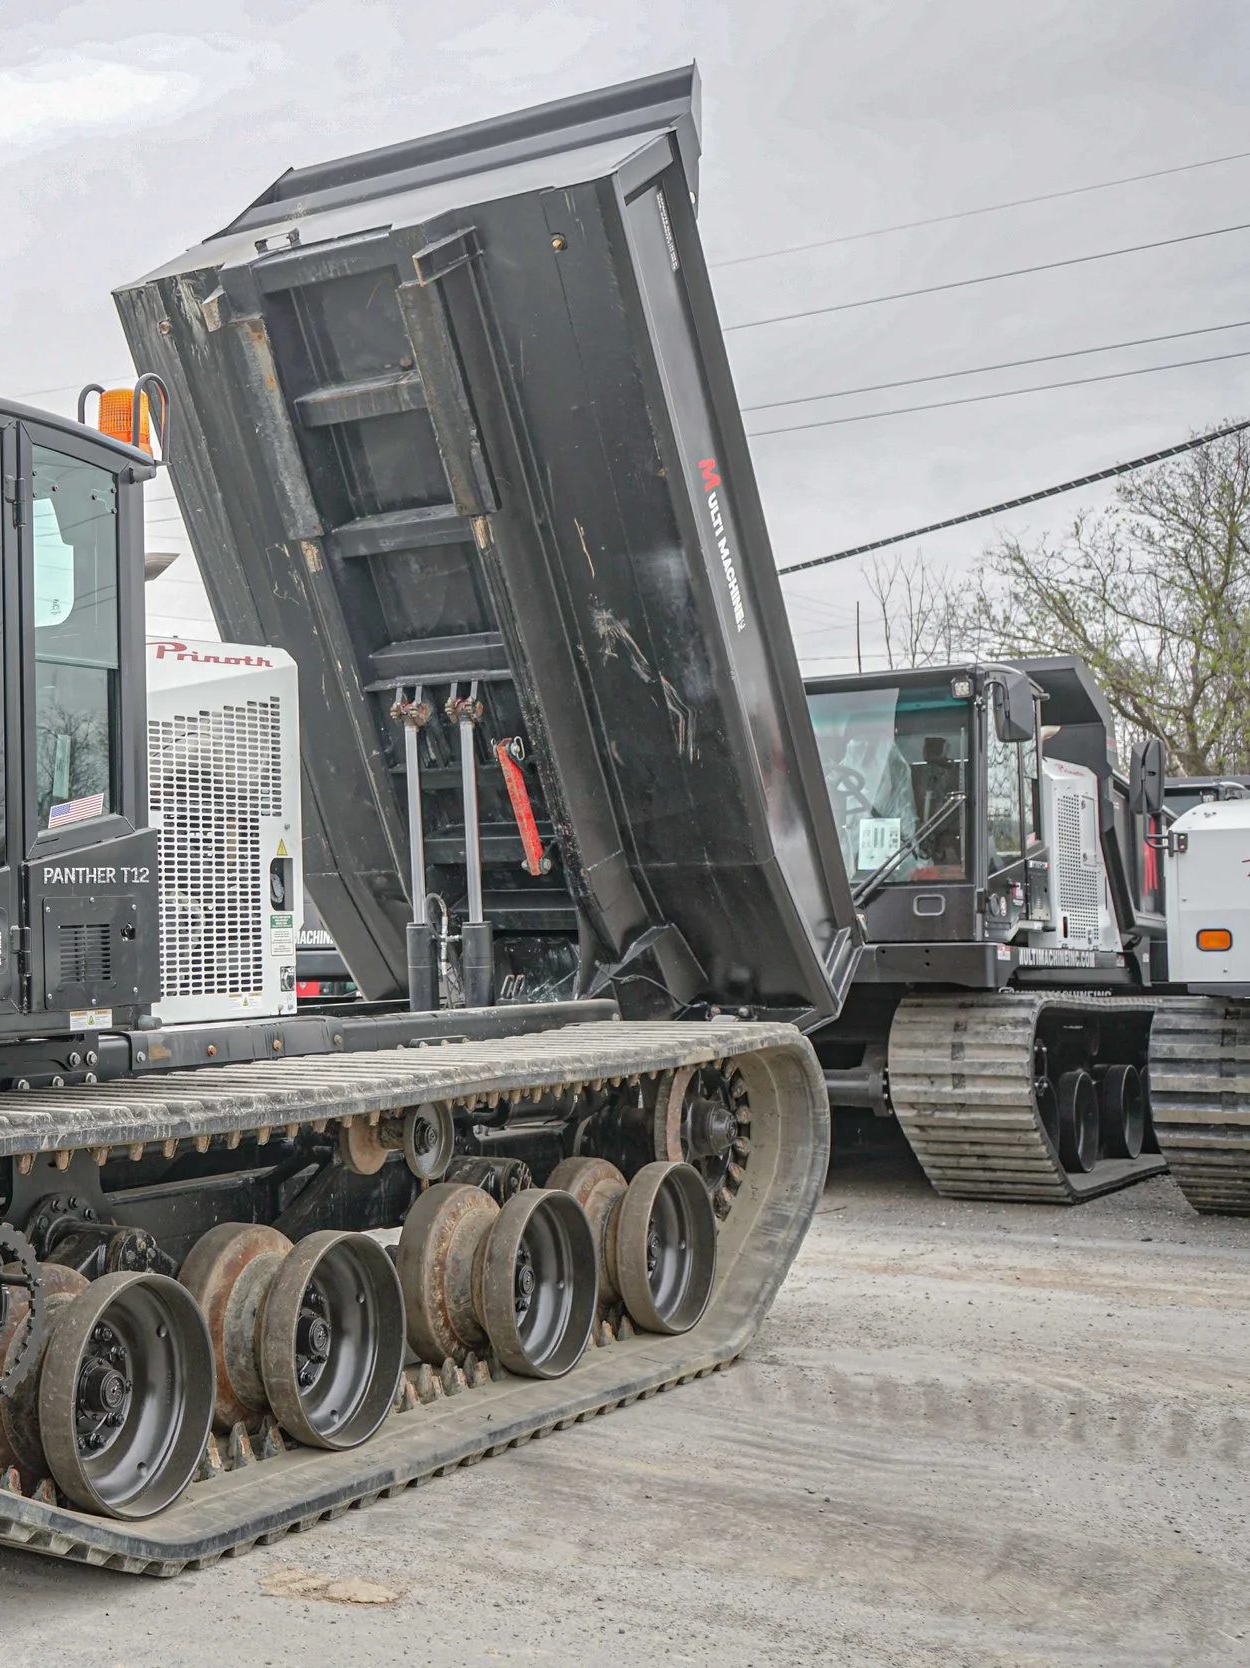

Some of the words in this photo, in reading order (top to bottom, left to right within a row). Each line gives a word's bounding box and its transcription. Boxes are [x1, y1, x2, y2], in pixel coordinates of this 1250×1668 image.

[696, 457, 725, 537] MULTI
[717, 535, 745, 628] MACHINE
[144, 641, 273, 668] Prinoth
[43, 867, 116, 884] PANTHER
[120, 867, 150, 883] T12
